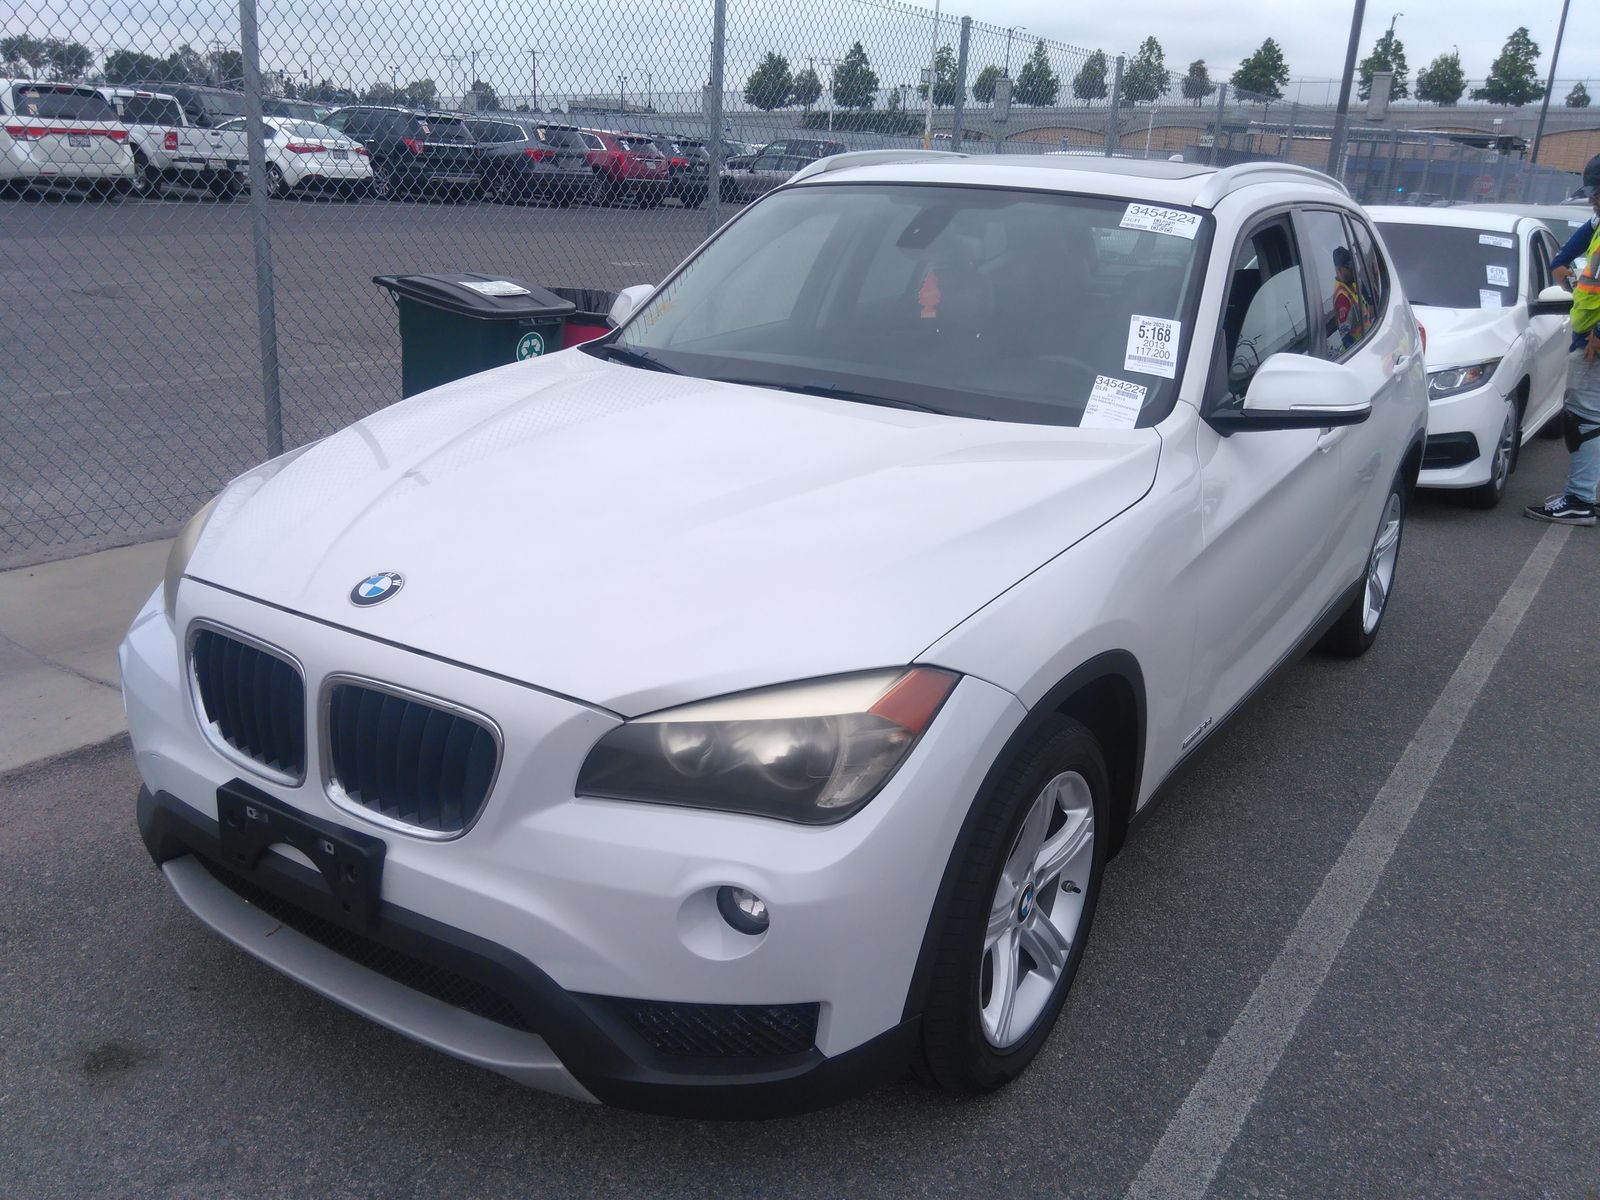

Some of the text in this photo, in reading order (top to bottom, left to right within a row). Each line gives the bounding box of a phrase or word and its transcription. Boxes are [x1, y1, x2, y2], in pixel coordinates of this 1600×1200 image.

[1130, 205, 1196, 225] 3454224
[1138, 325, 1171, 342] 5:168
[1143, 339, 1165, 349] 2013
[1095, 376, 1146, 396] 3454224
